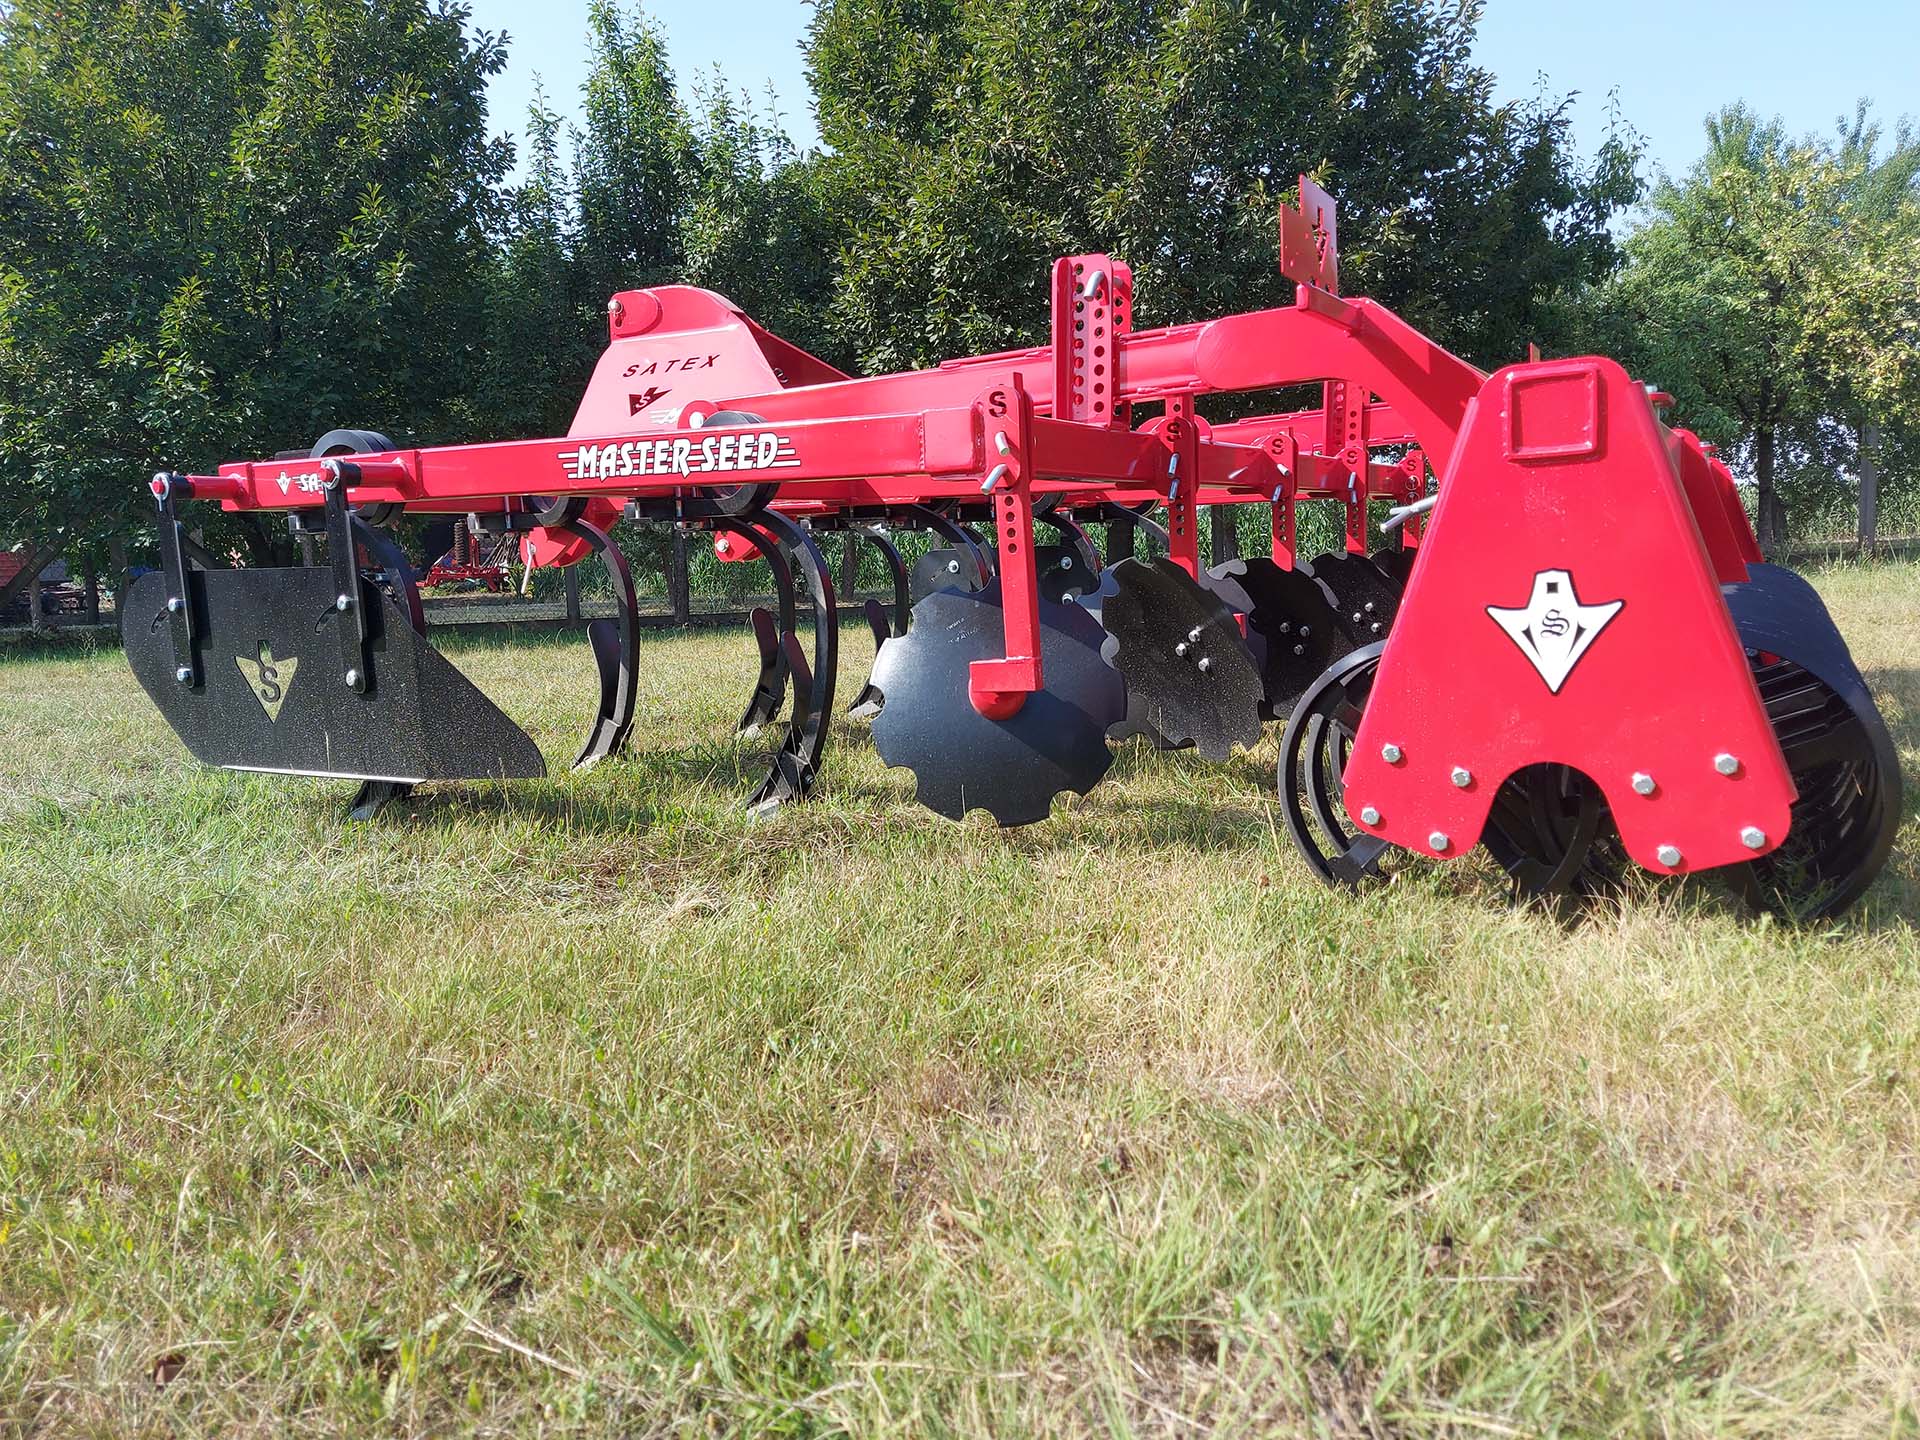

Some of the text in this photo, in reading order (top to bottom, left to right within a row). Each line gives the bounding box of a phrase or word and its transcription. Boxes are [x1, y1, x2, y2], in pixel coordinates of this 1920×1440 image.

[622, 354, 720, 378] SATEX
[988, 391, 1007, 418] S
[1166, 422, 1182, 443] S
[577, 432, 779, 482] MASTER SEED
[1271, 438, 1285, 456] S
[1346, 450, 1358, 465] S
[1406, 459, 1417, 472] S
[1540, 608, 1570, 638] S
